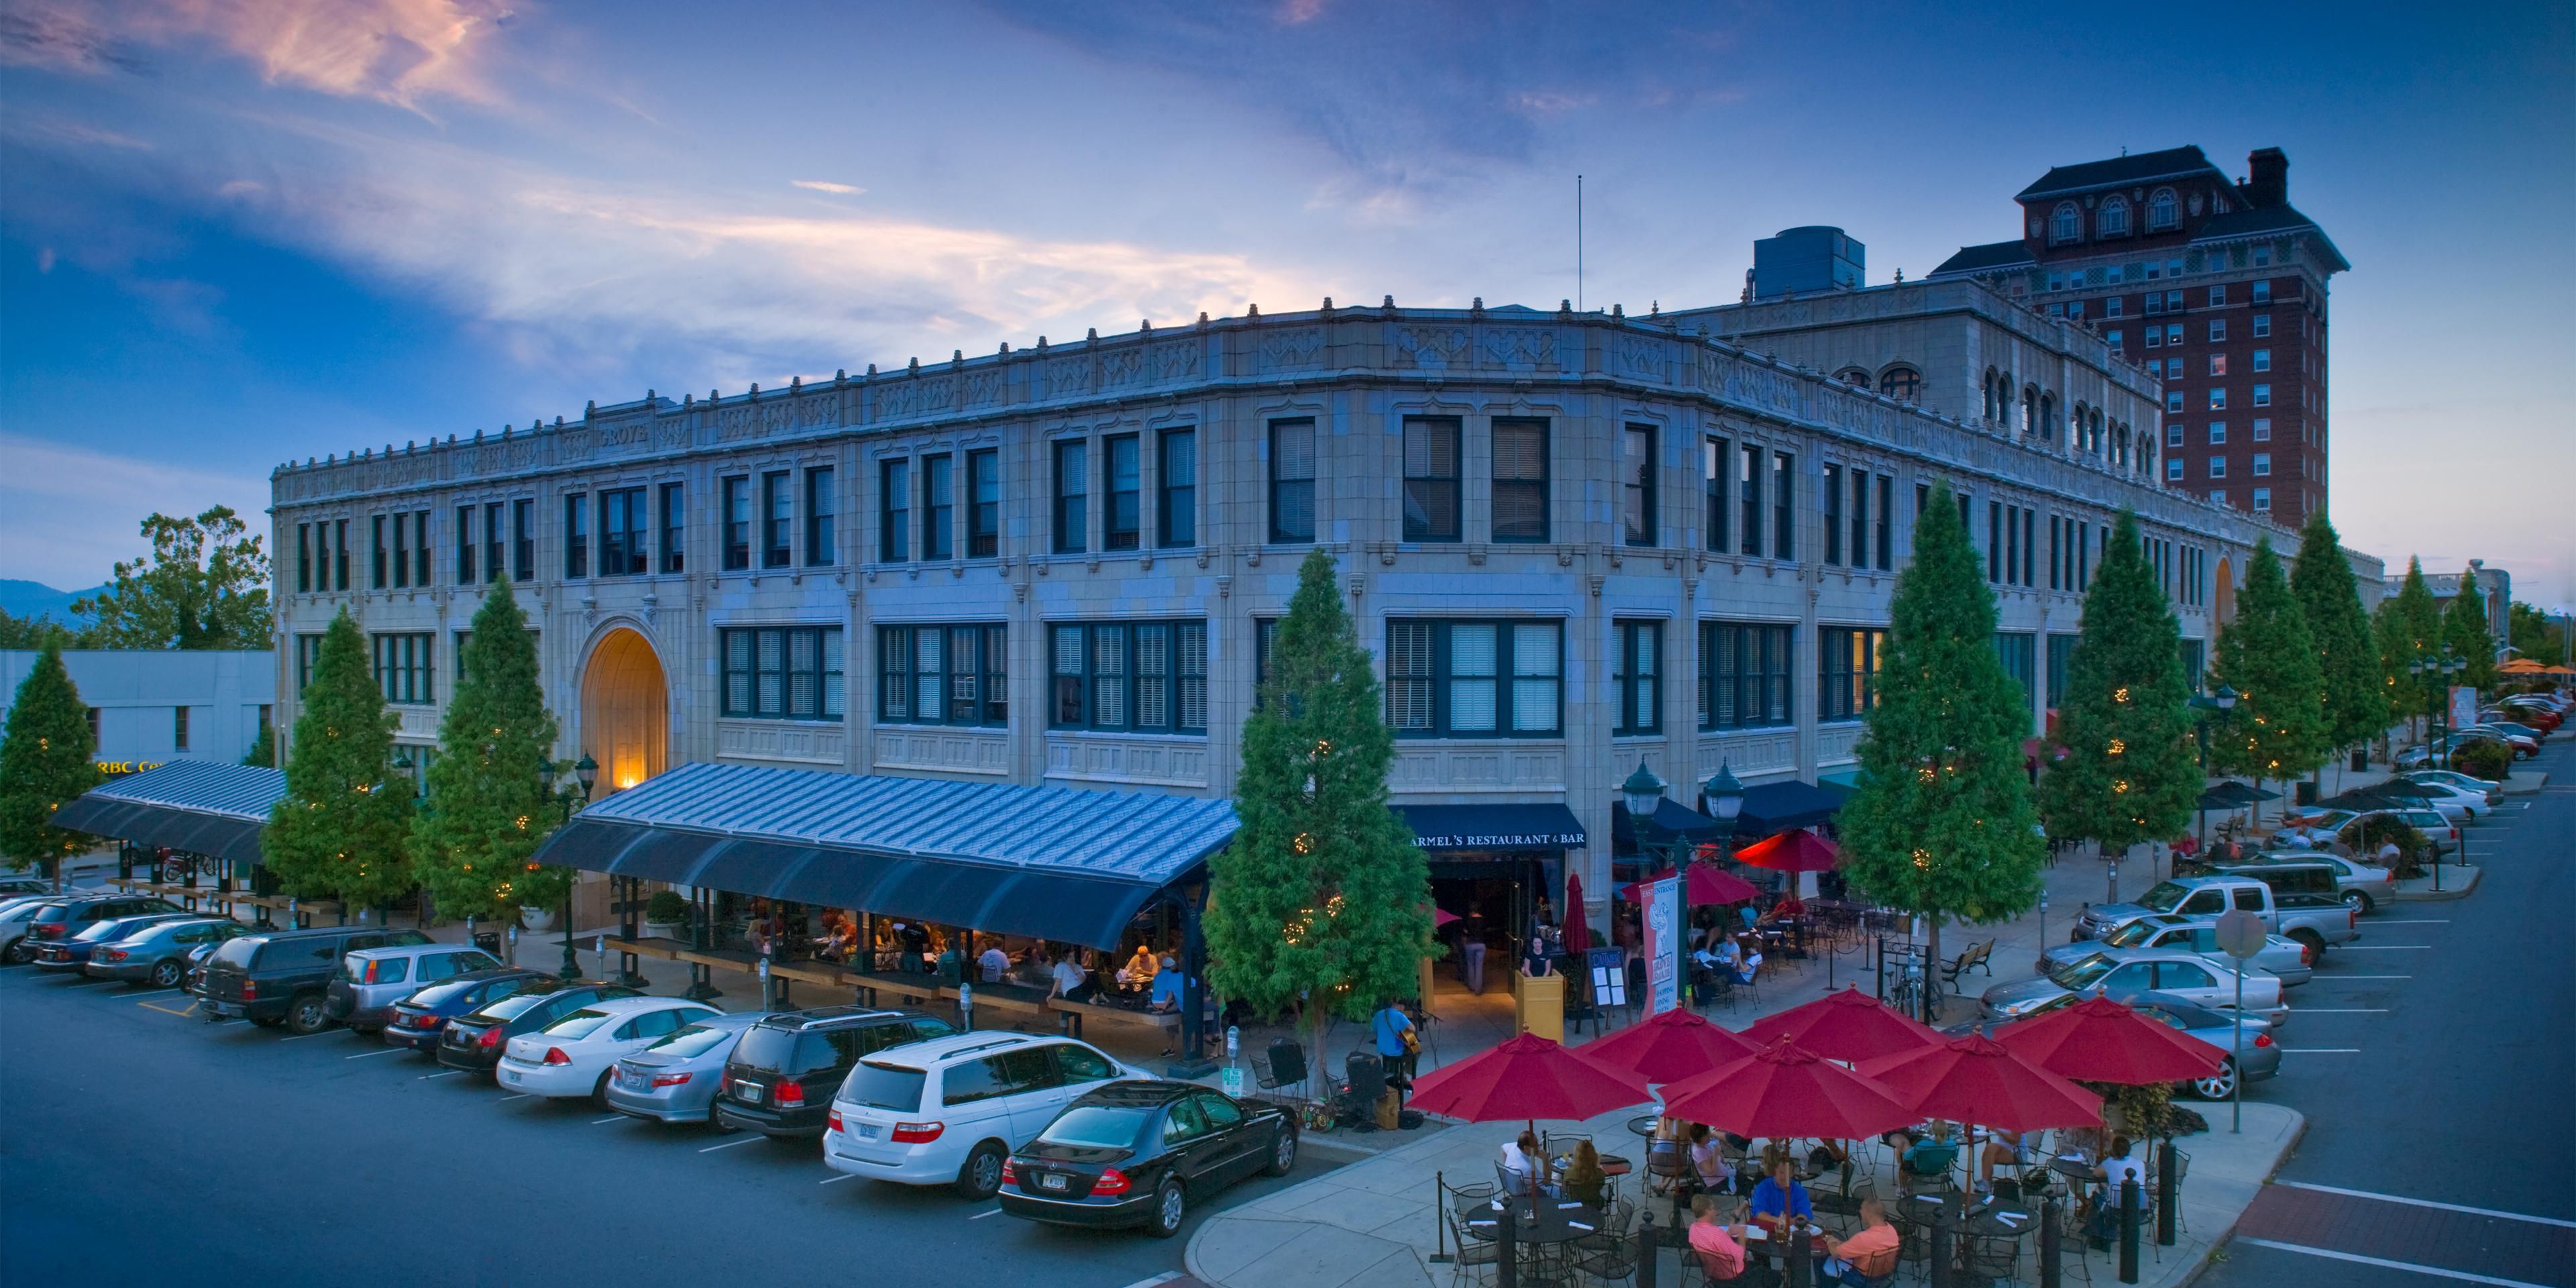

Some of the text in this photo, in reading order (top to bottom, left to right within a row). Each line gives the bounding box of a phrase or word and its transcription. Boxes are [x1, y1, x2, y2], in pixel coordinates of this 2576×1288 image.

[601, 425, 648, 447] GROVE
[97, 761, 162, 773] RBC Ce
[1410, 835, 1462, 847] ARMEL'S
[1466, 835, 1550, 845] RESTAURANT
[1560, 833, 1585, 843] BAR
[1642, 884, 1675, 898] EAST ENTRANCE
